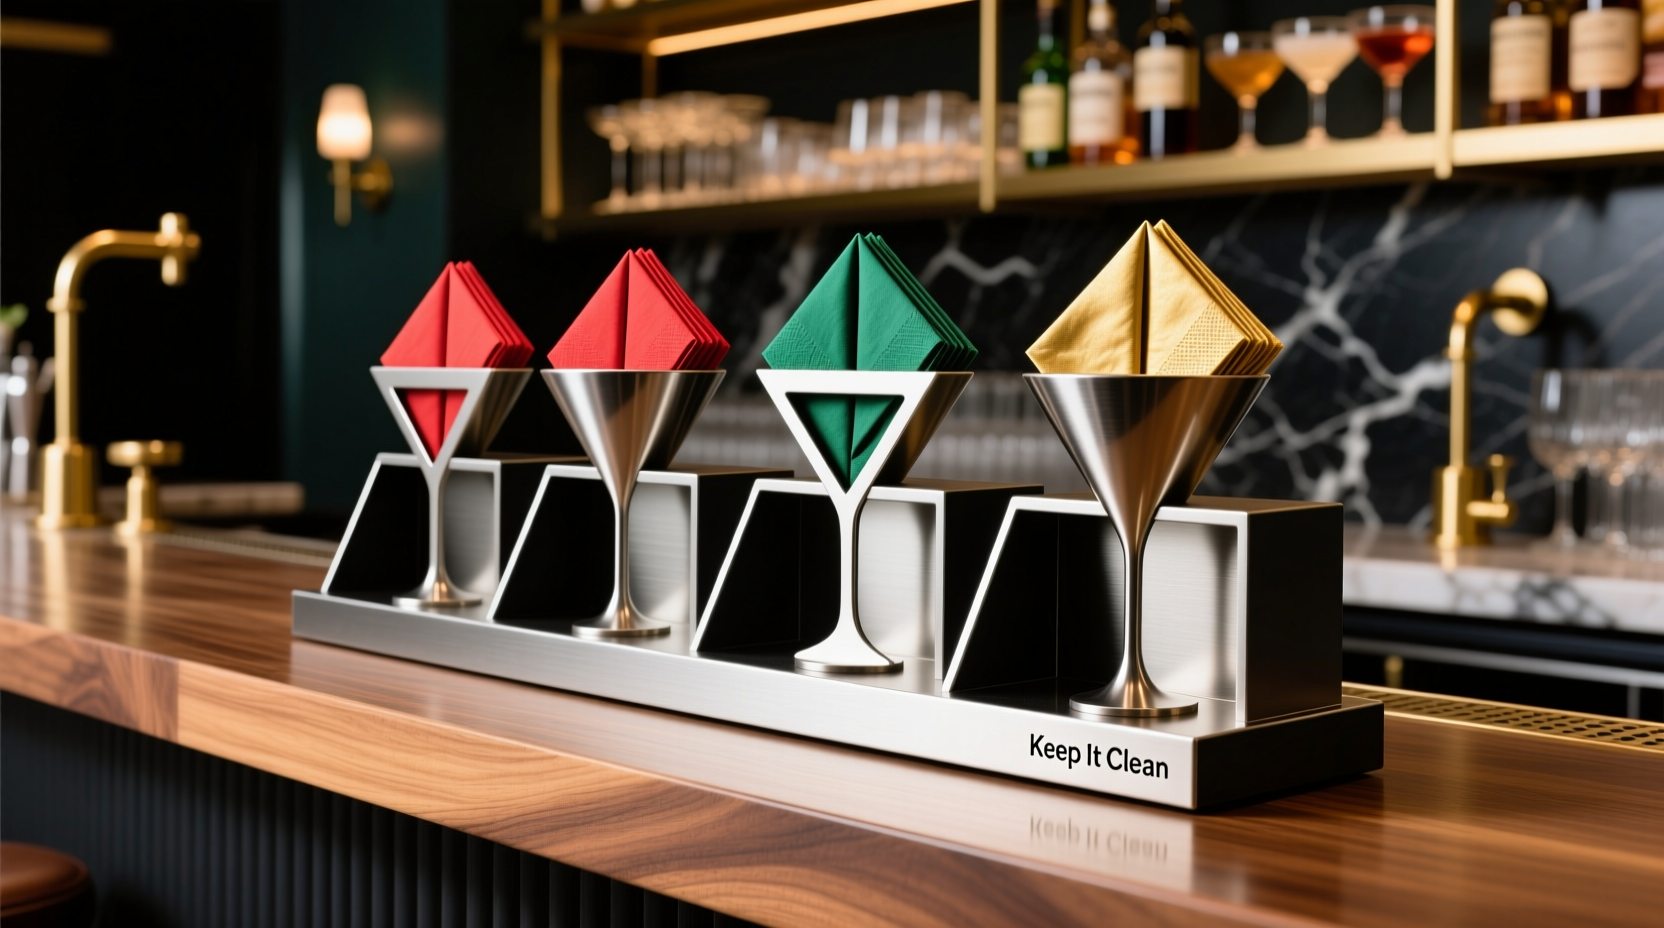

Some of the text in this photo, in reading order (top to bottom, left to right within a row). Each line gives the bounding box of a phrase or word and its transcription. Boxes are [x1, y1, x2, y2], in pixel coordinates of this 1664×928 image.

[1030, 733, 1169, 779] Keep It Clean
